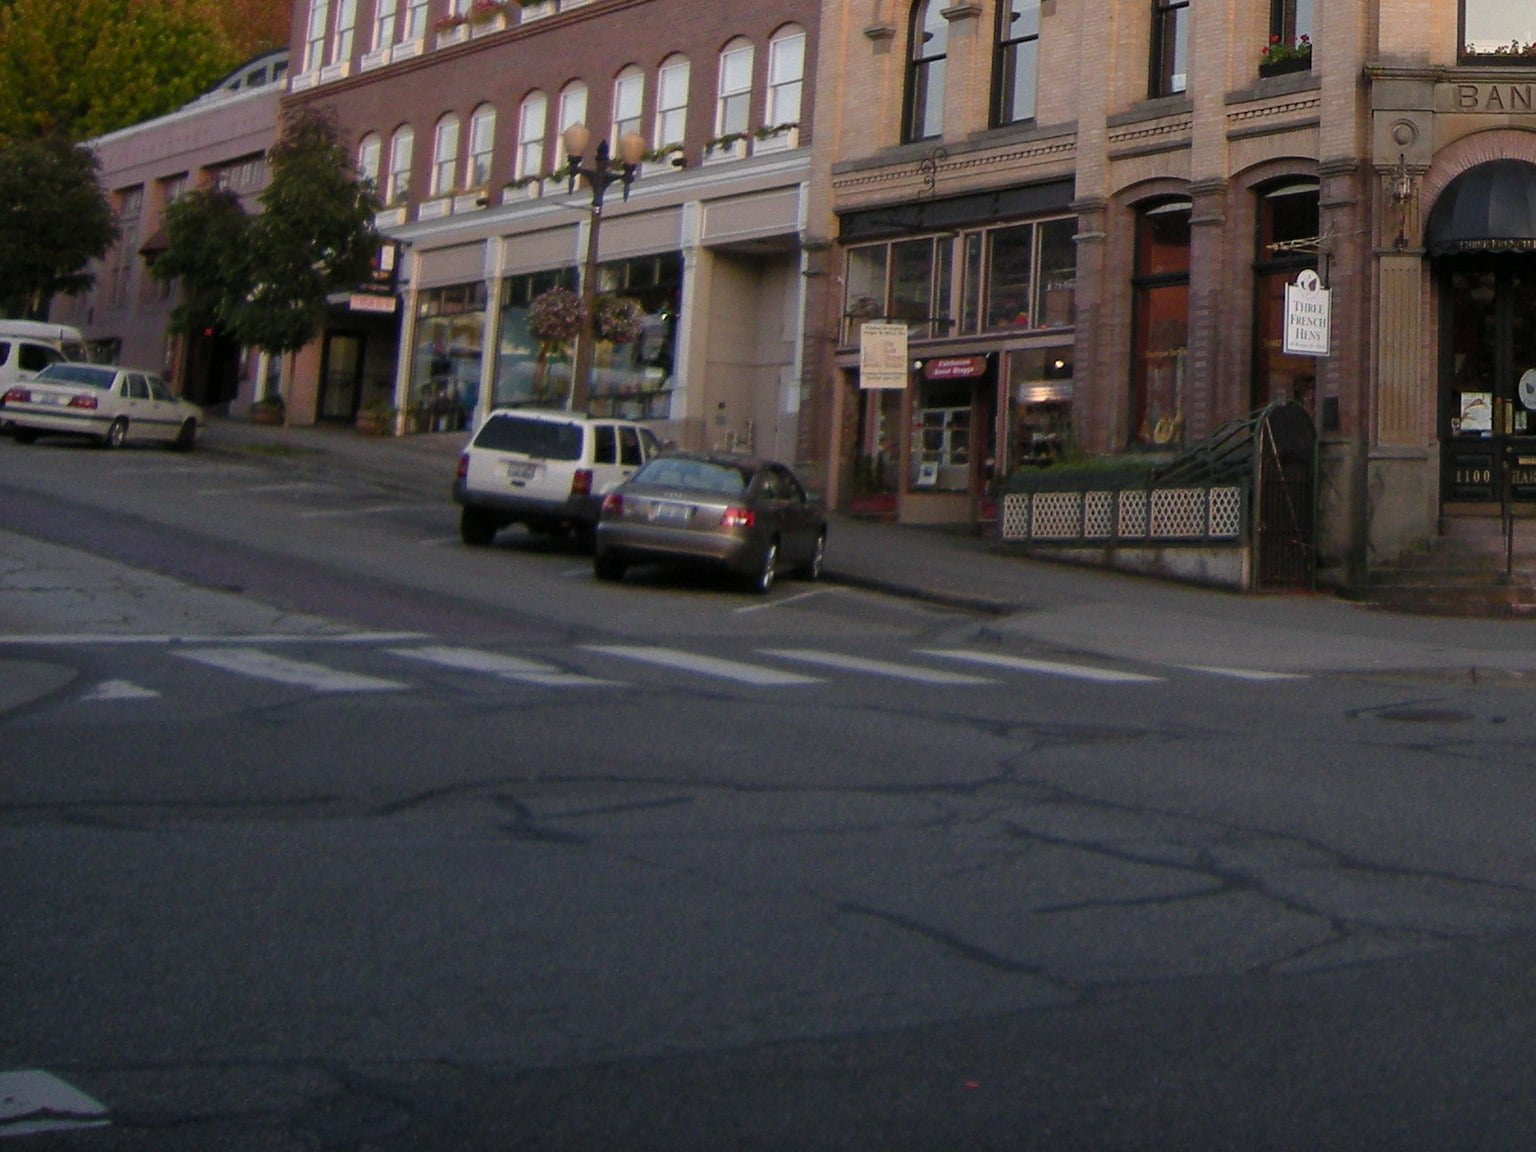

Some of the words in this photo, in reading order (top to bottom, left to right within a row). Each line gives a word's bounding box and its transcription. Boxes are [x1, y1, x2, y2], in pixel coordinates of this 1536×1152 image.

[1293, 299, 1325, 314] THREE
[1290, 314, 1326, 328] FRENCH
[1296, 328, 1321, 340] HENS
[1456, 470, 1491, 482] 1100
